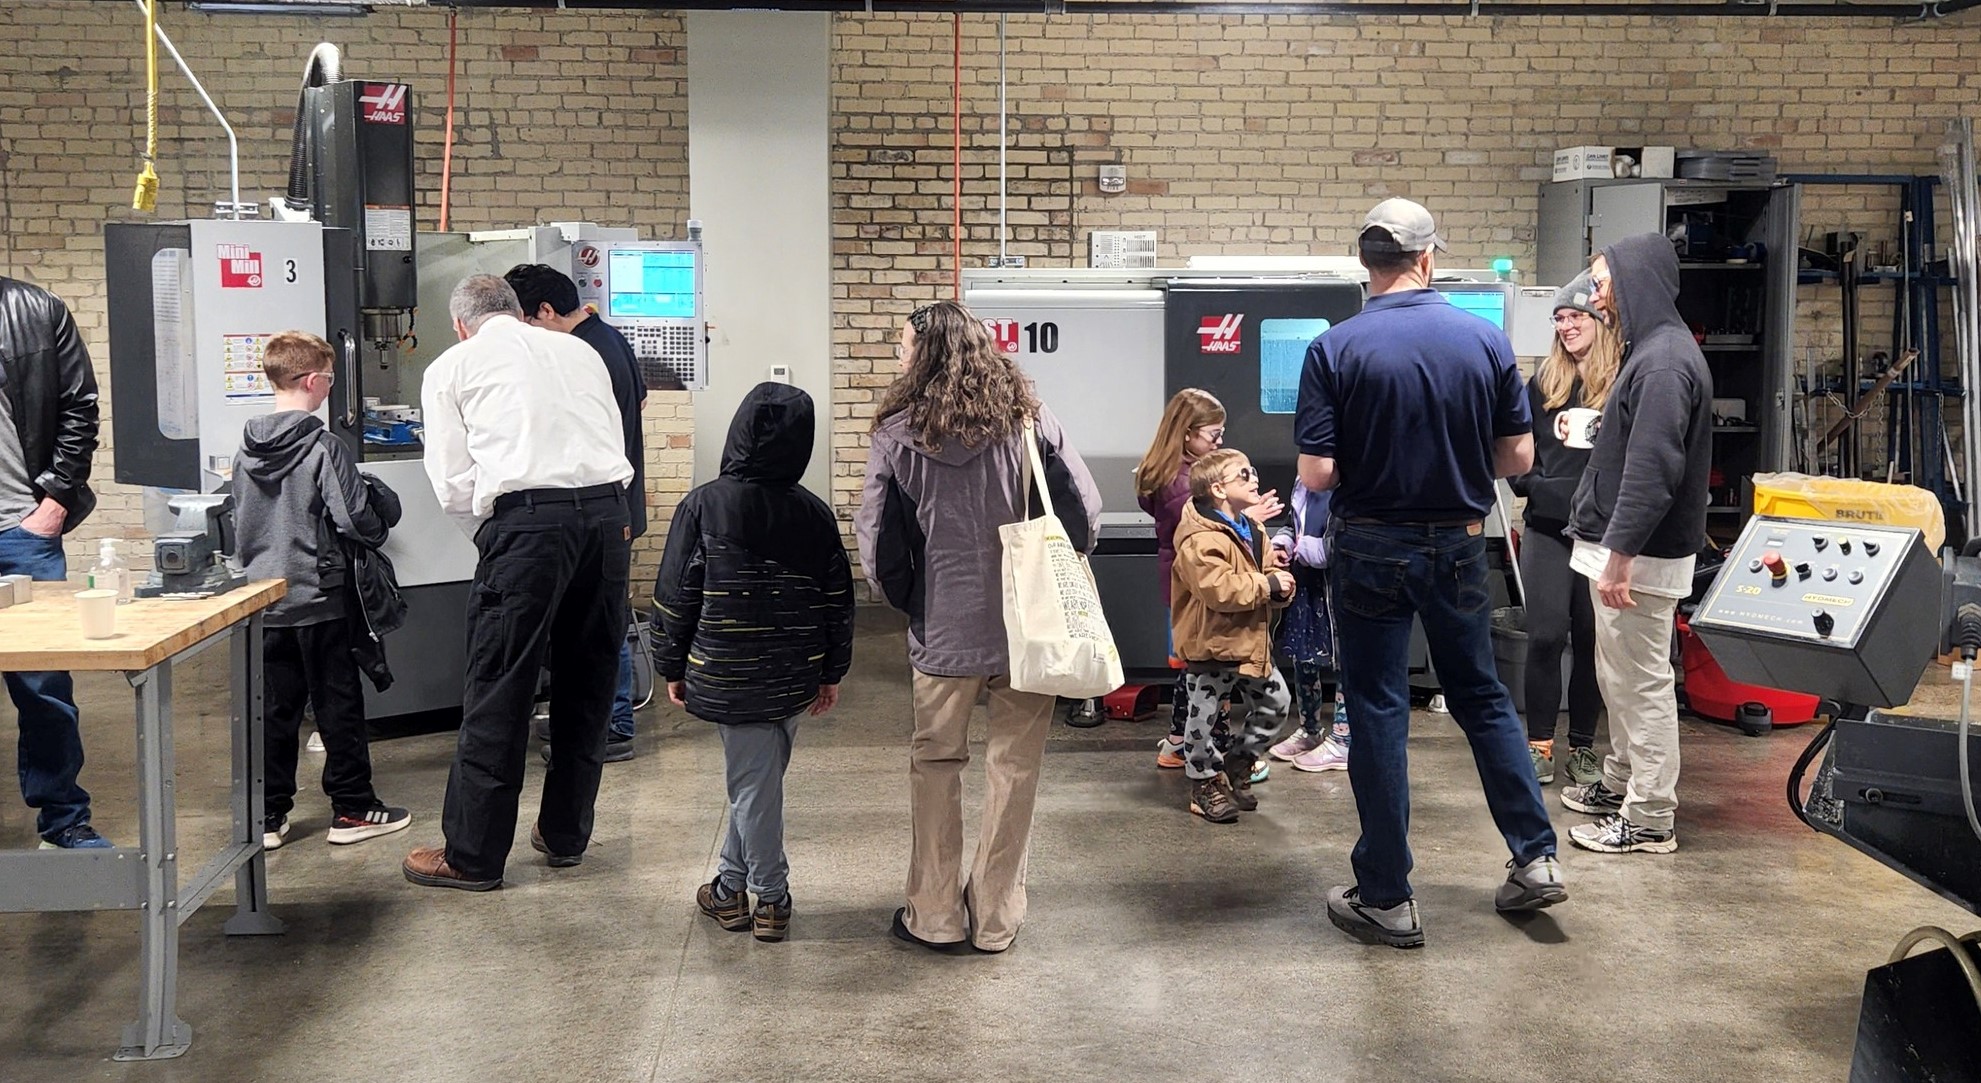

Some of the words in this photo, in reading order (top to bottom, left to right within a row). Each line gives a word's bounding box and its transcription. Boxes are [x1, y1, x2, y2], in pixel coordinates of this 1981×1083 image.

[364, 111, 404, 122] HAAS
[217, 244, 249, 259] Mini
[231, 260, 260, 274] Mill
[286, 259, 297, 283] 3
[981, 318, 1014, 341] ST
[1024, 322, 1058, 353] 10
[1201, 341, 1240, 351] HAAS
